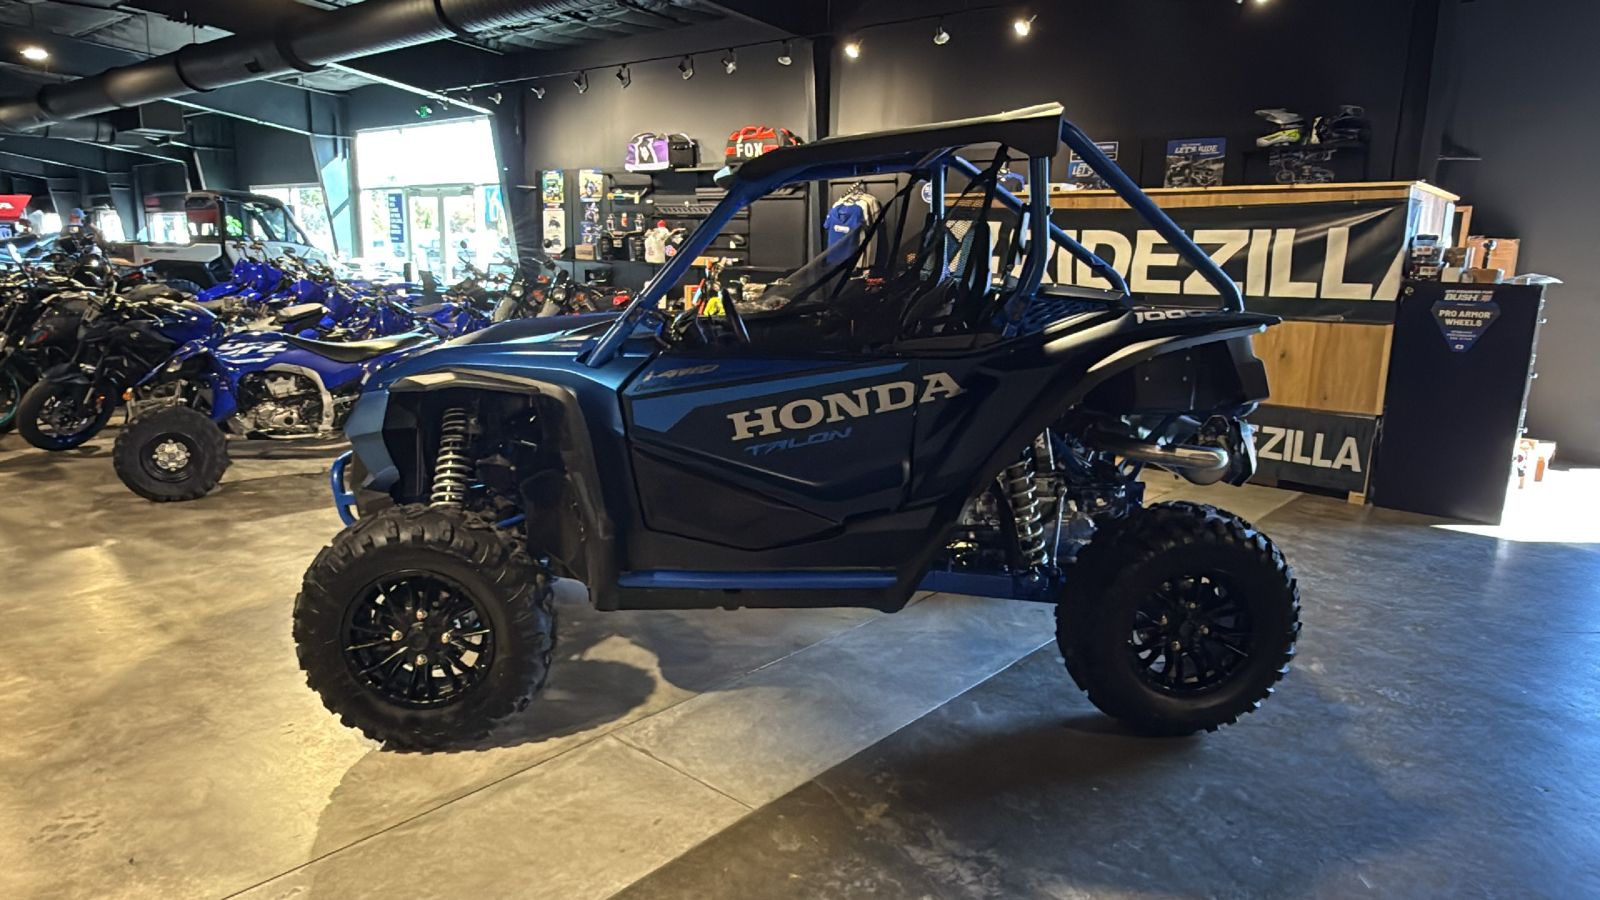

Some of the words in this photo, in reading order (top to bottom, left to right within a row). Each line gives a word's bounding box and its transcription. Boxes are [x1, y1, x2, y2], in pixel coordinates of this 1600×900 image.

[736, 142, 763, 158] FOX
[1198, 144, 1219, 153] RIDE
[1438, 309, 1458, 318] PRO
[1458, 310, 1491, 319] ARMOR
[1444, 318, 1483, 327] WHEELS
[726, 371, 968, 441] HONDA
[744, 427, 853, 456] TALON
